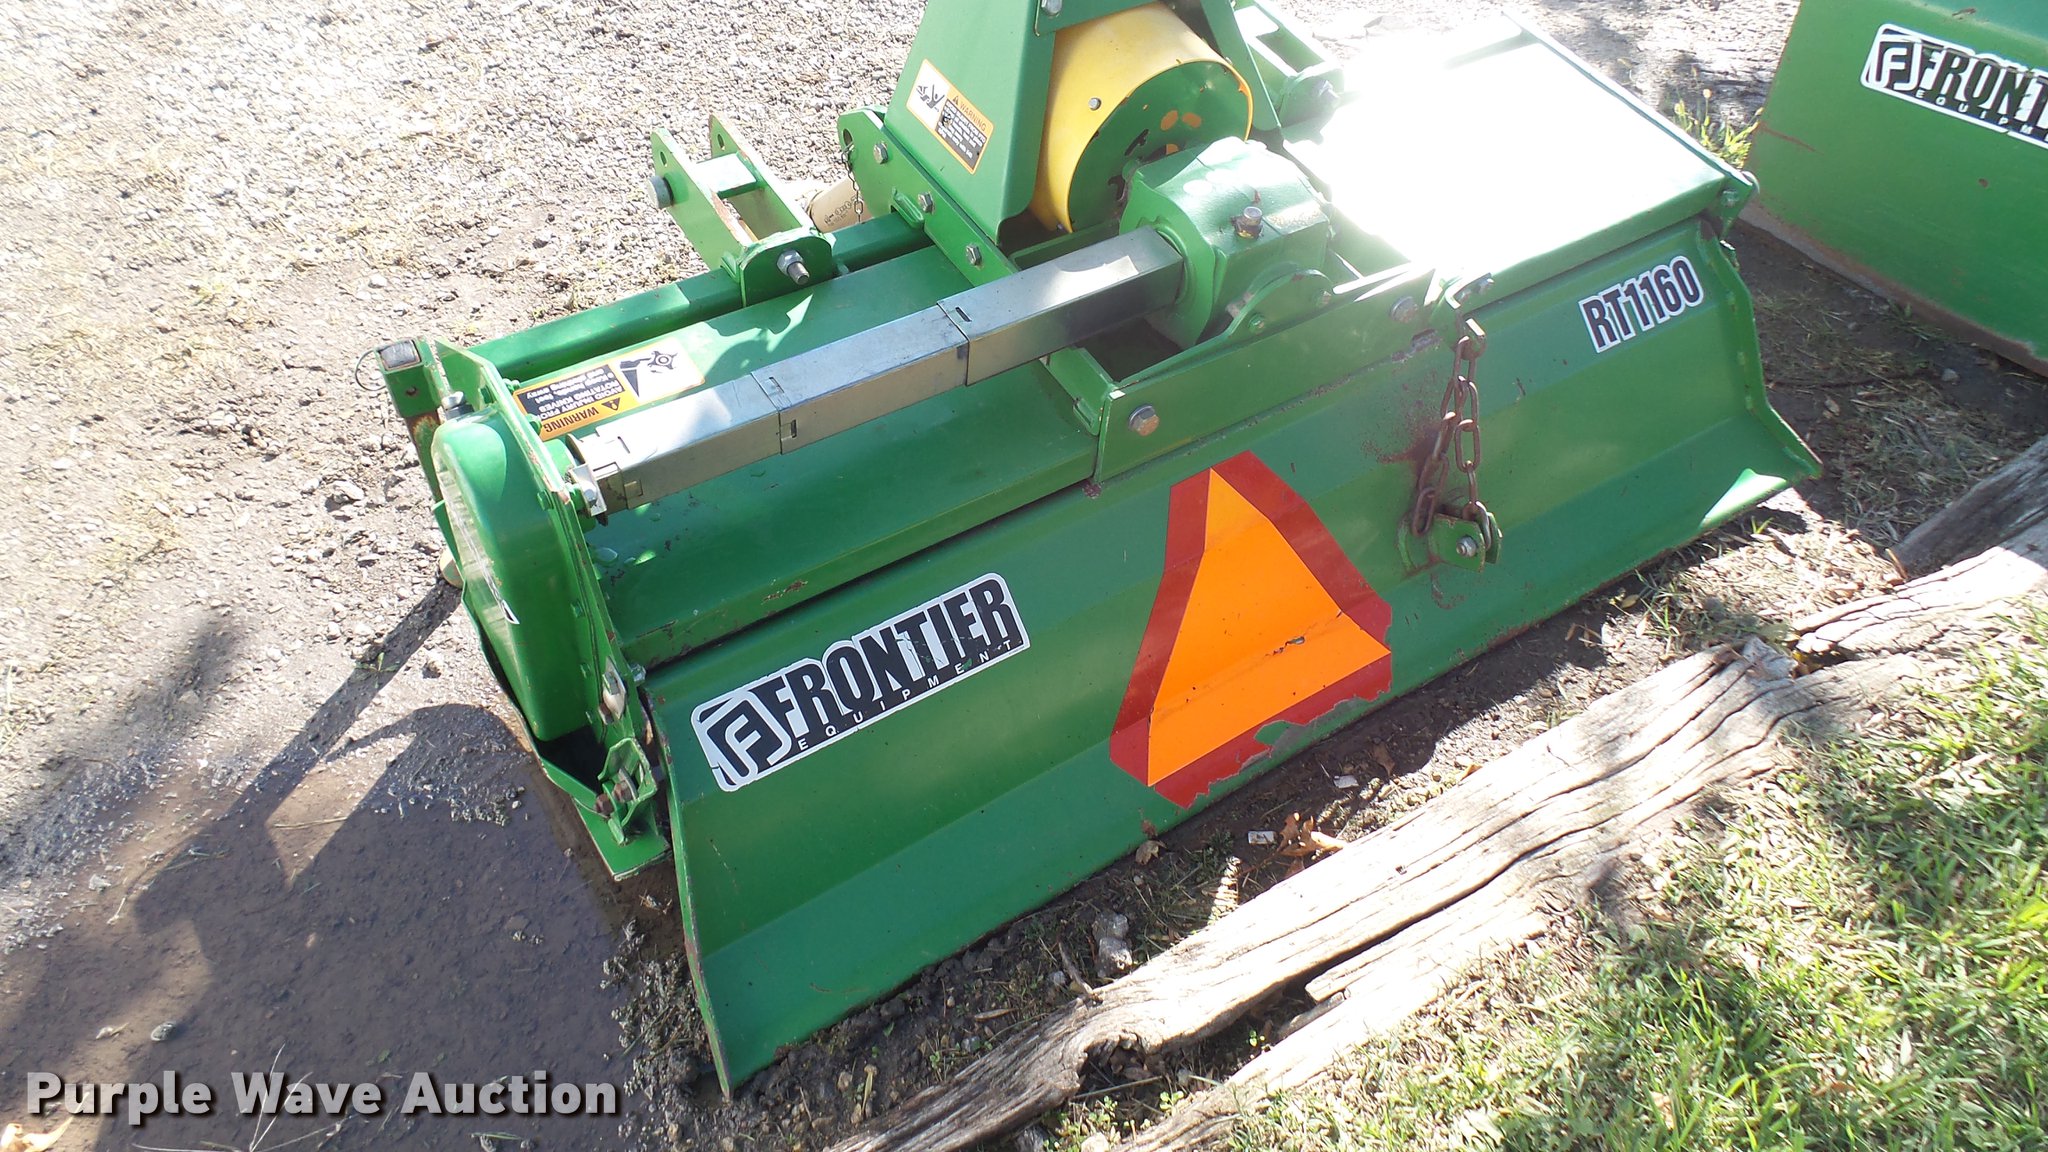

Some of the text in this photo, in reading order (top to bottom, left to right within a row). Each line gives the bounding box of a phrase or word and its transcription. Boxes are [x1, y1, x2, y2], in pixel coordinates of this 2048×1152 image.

[1582, 260, 1701, 349] RT1160
[538, 380, 619, 412] ROTATING KNIVES
[561, 396, 594, 412] INJURY
[593, 386, 622, 400] AVOID
[543, 406, 598, 432] WARNING
[750, 579, 1024, 740] FRONTIER
[798, 638, 1014, 751] EQUIPMENT
